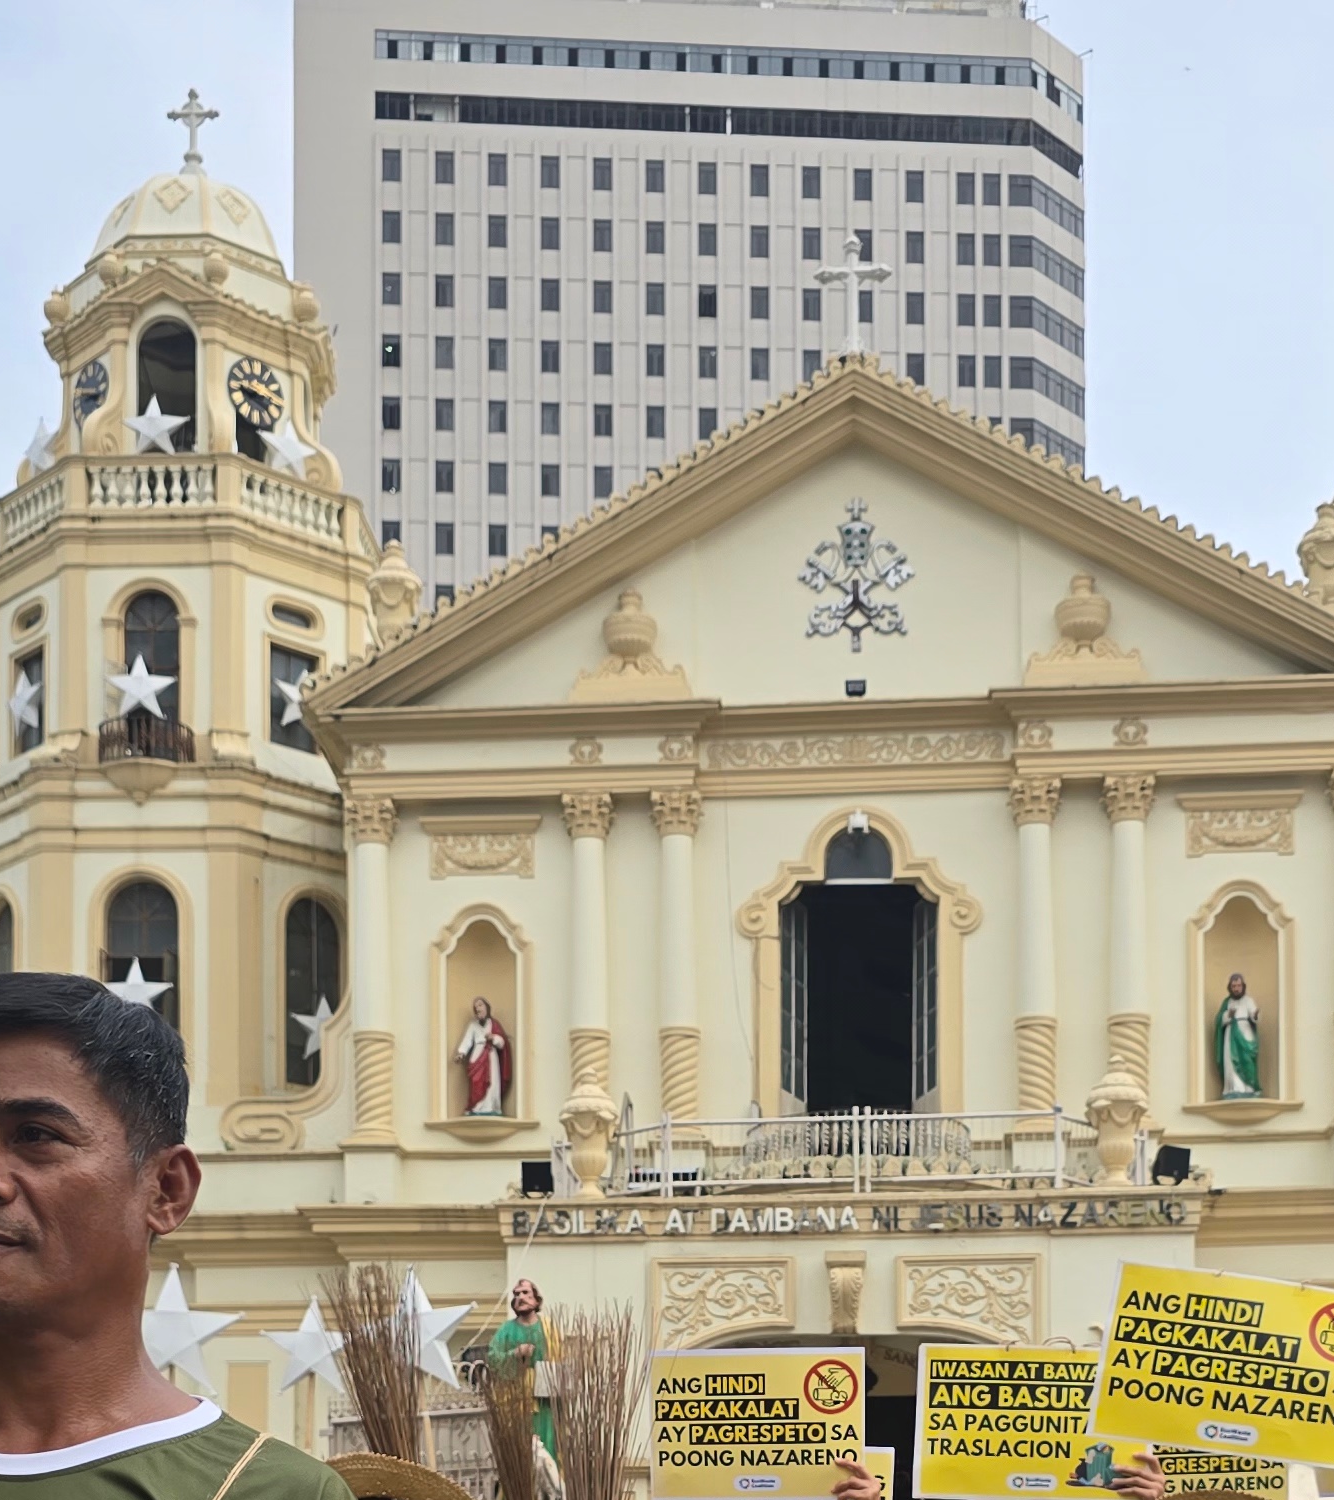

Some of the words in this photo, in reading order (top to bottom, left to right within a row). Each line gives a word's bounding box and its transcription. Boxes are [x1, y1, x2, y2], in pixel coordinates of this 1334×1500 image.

[1014, 1198, 1187, 1229] NAZARENO
[1123, 1290, 1182, 1314] ANG
[1188, 1296, 1261, 1326] HINDI
[1117, 1318, 1298, 1360] PAGKAKALAT
[931, 1361, 1009, 1379] IWASAN
[1013, 1362, 1036, 1379] AT
[1043, 1363, 1099, 1381] BAWA
[1112, 1348, 1151, 1370] AY
[1154, 1353, 1327, 1393] PAGRESPETO
[657, 1377, 702, 1395] ANG
[708, 1375, 764, 1394] HINDI
[1109, 1376, 1205, 1407] POONG
[932, 1384, 992, 1407] ANG
[657, 1400, 798, 1420] PAGKAKALAT
[928, 1412, 957, 1431] SA
[657, 1426, 686, 1443] AY
[691, 1424, 825, 1444] PAGRESPETO
[830, 1424, 859, 1441] SA
[659, 1449, 735, 1467] POONG
[927, 1437, 1071, 1459] TRASLACION
[1162, 1457, 1255, 1474] GRESPETO
[1181, 1475, 1285, 1493] NAZARENO
